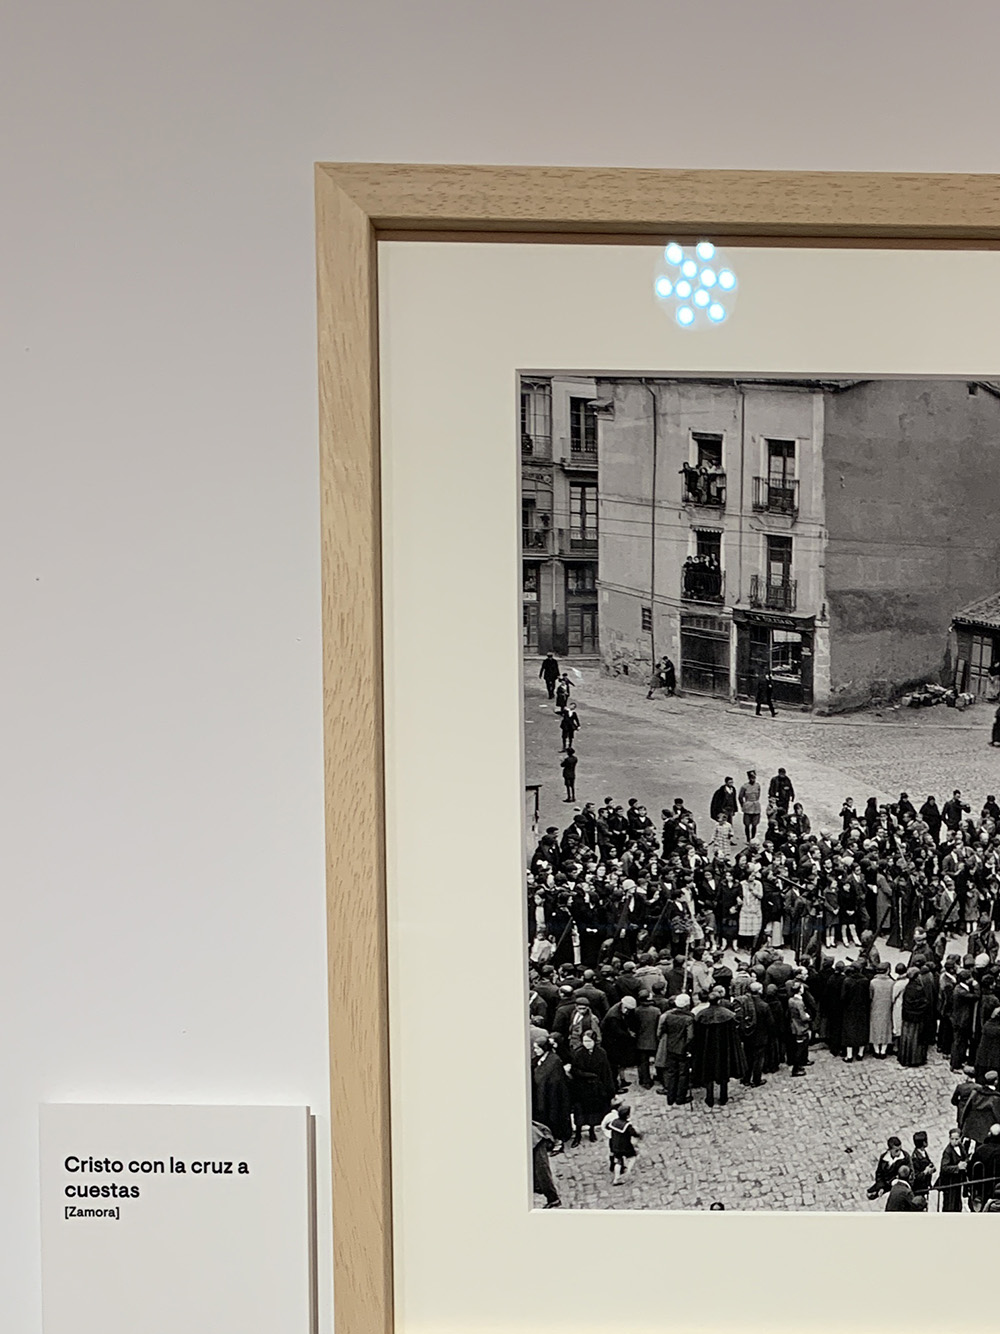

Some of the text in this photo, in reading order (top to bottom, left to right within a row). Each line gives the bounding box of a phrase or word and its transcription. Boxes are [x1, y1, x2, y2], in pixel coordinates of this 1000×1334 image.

[65, 1156, 249, 1174] Cristo con la cruz a
[65, 1183, 140, 1198] cuestas
[65, 1206, 119, 1220] [Zamora]
